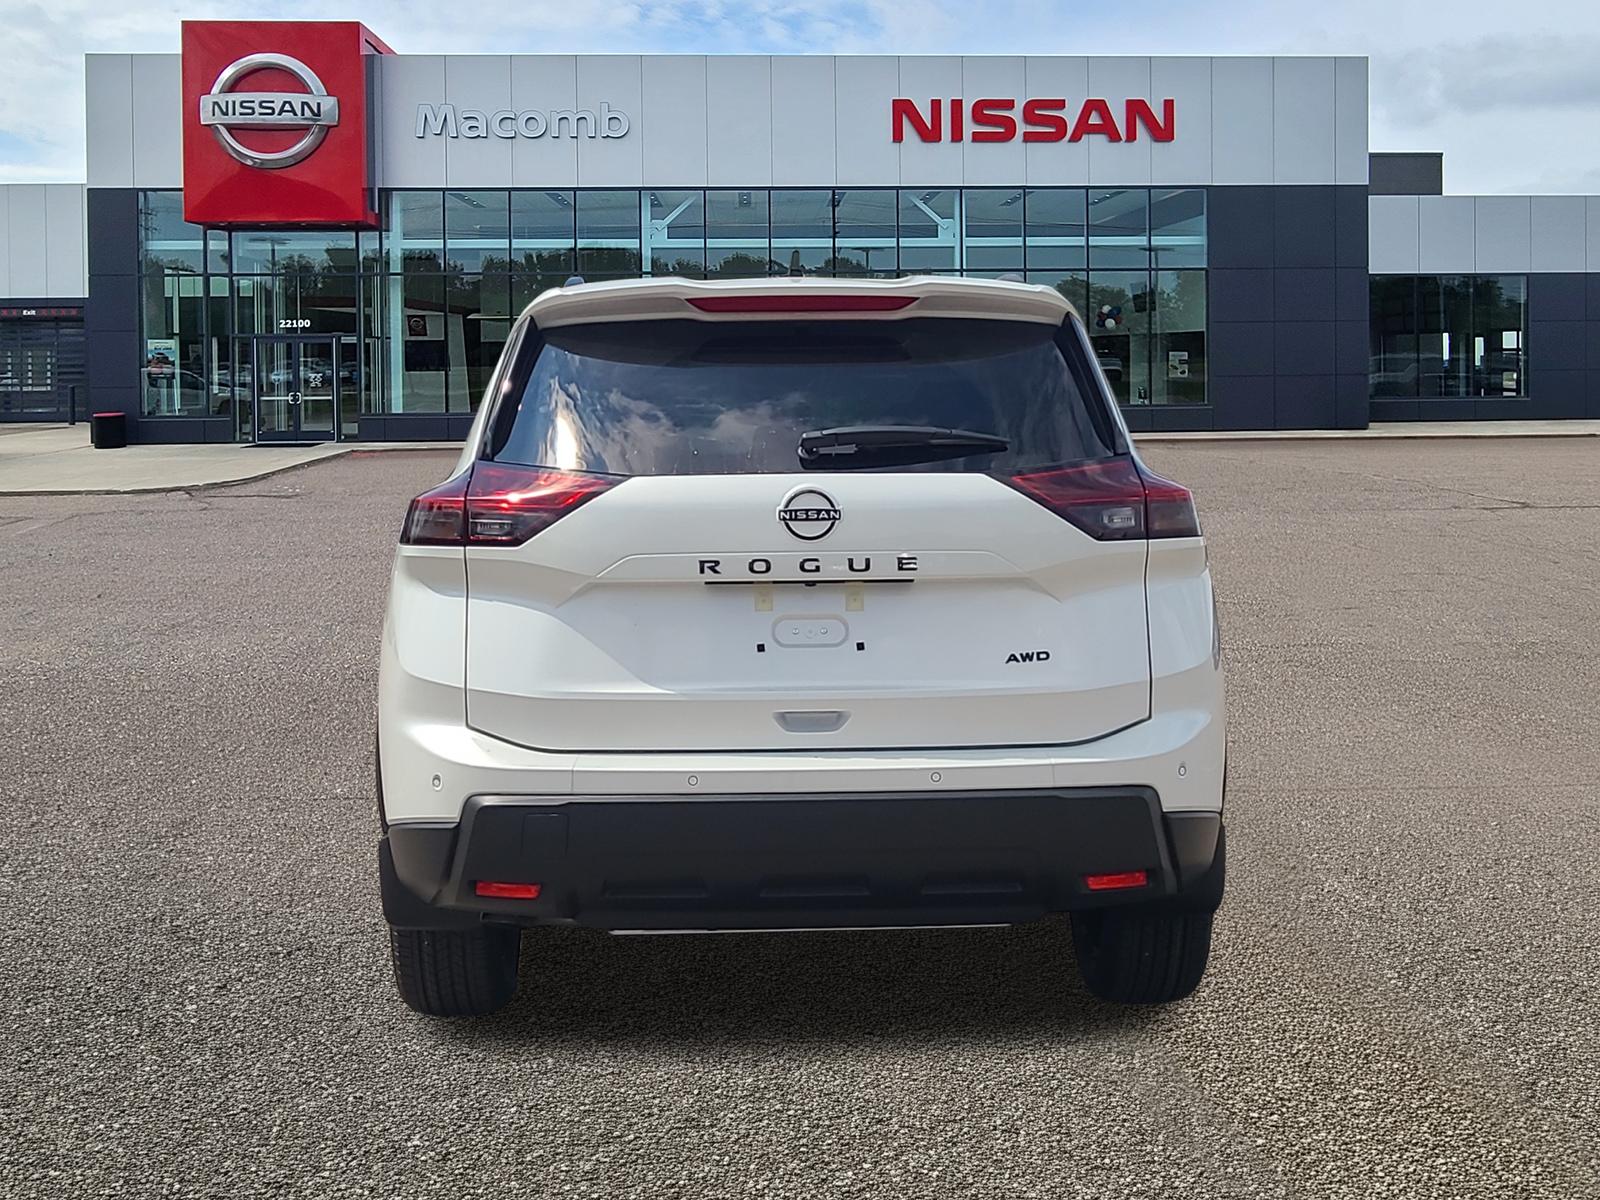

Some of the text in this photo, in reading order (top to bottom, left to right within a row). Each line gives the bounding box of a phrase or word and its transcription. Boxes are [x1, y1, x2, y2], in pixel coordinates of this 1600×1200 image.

[211, 99, 322, 118] NISSAN
[415, 101, 631, 139] Macomb
[891, 98, 1176, 143] NISSAN
[279, 319, 311, 328] 22100
[779, 510, 841, 520] NISSAN
[698, 556, 919, 575] ROGUE
[1005, 651, 1051, 664] AWD
